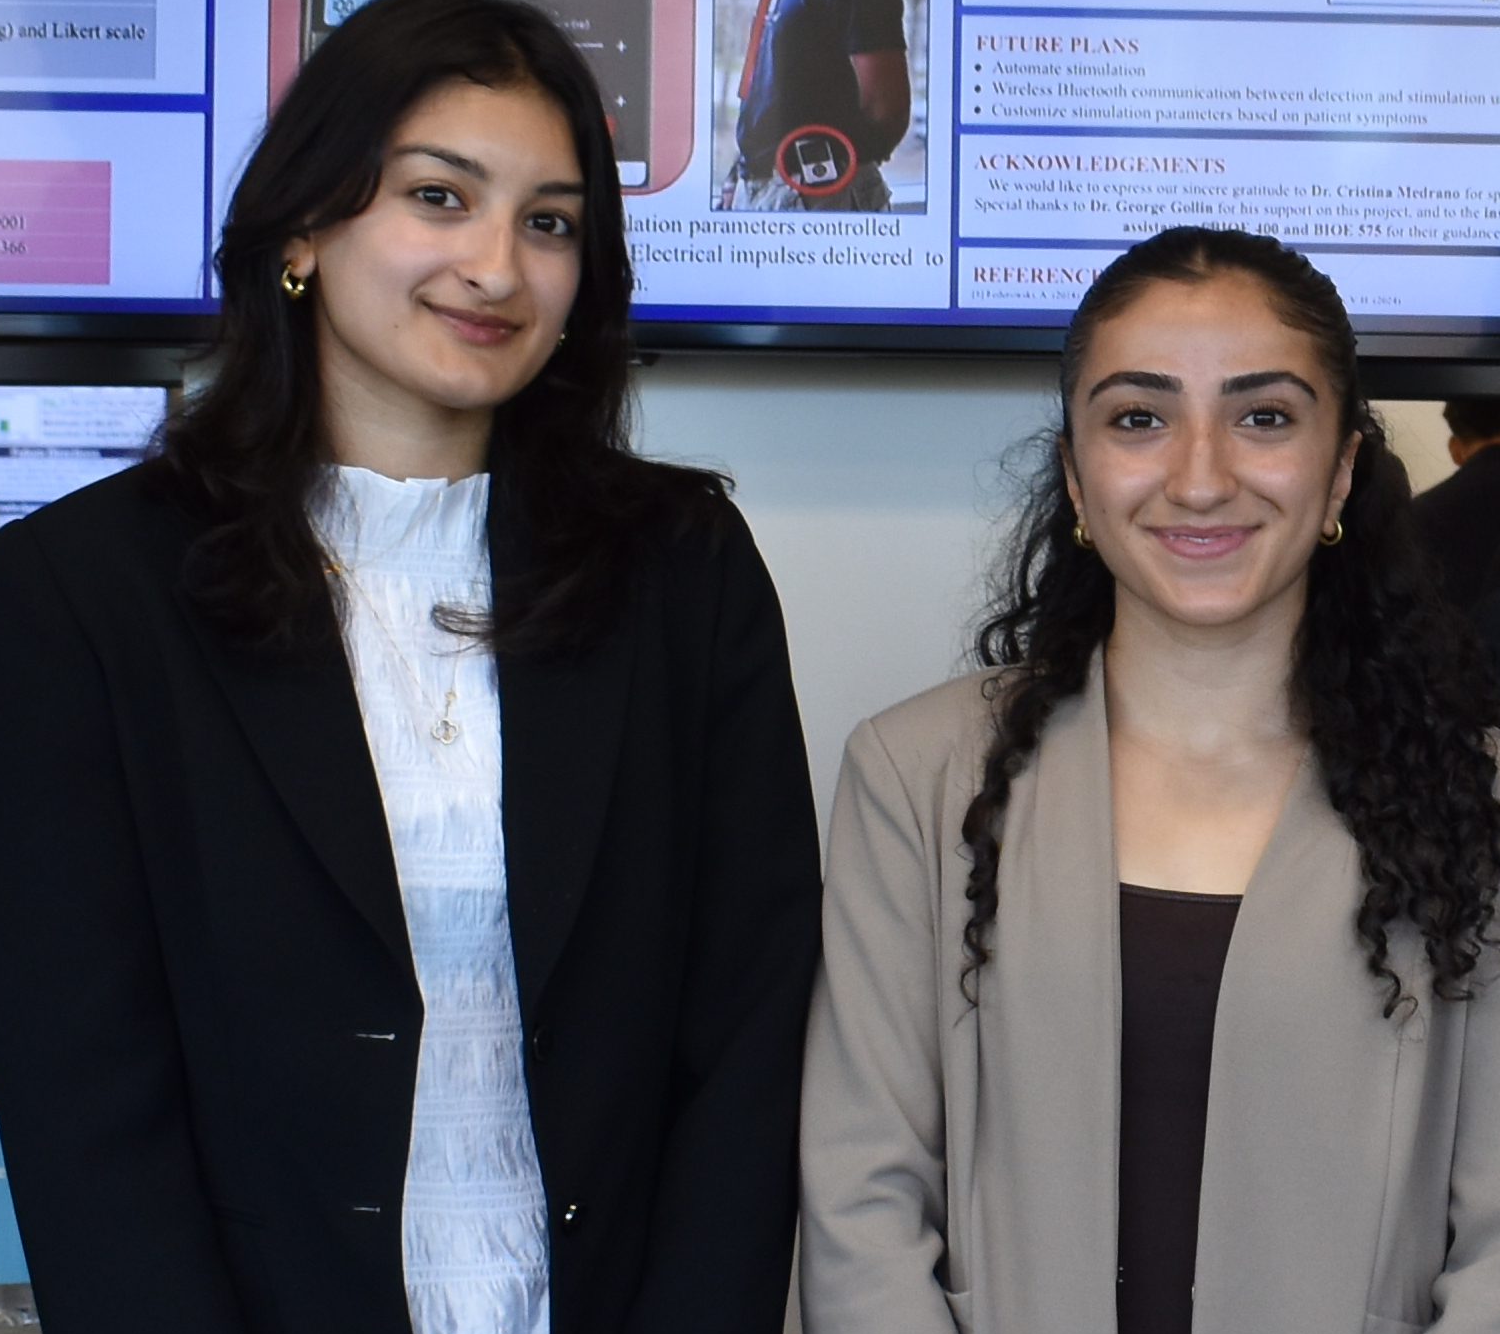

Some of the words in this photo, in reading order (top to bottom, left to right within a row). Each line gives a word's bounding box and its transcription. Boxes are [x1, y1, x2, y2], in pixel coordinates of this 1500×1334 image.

[18, 21, 47, 39] and
[52, 21, 100, 40] Likert
[105, 22, 145, 40] scale
[977, 35, 1062, 52] FUTURE
[1071, 36, 1138, 53] PLANS
[974, 154, 1225, 173] ACKNOWLEDGEMENTS
